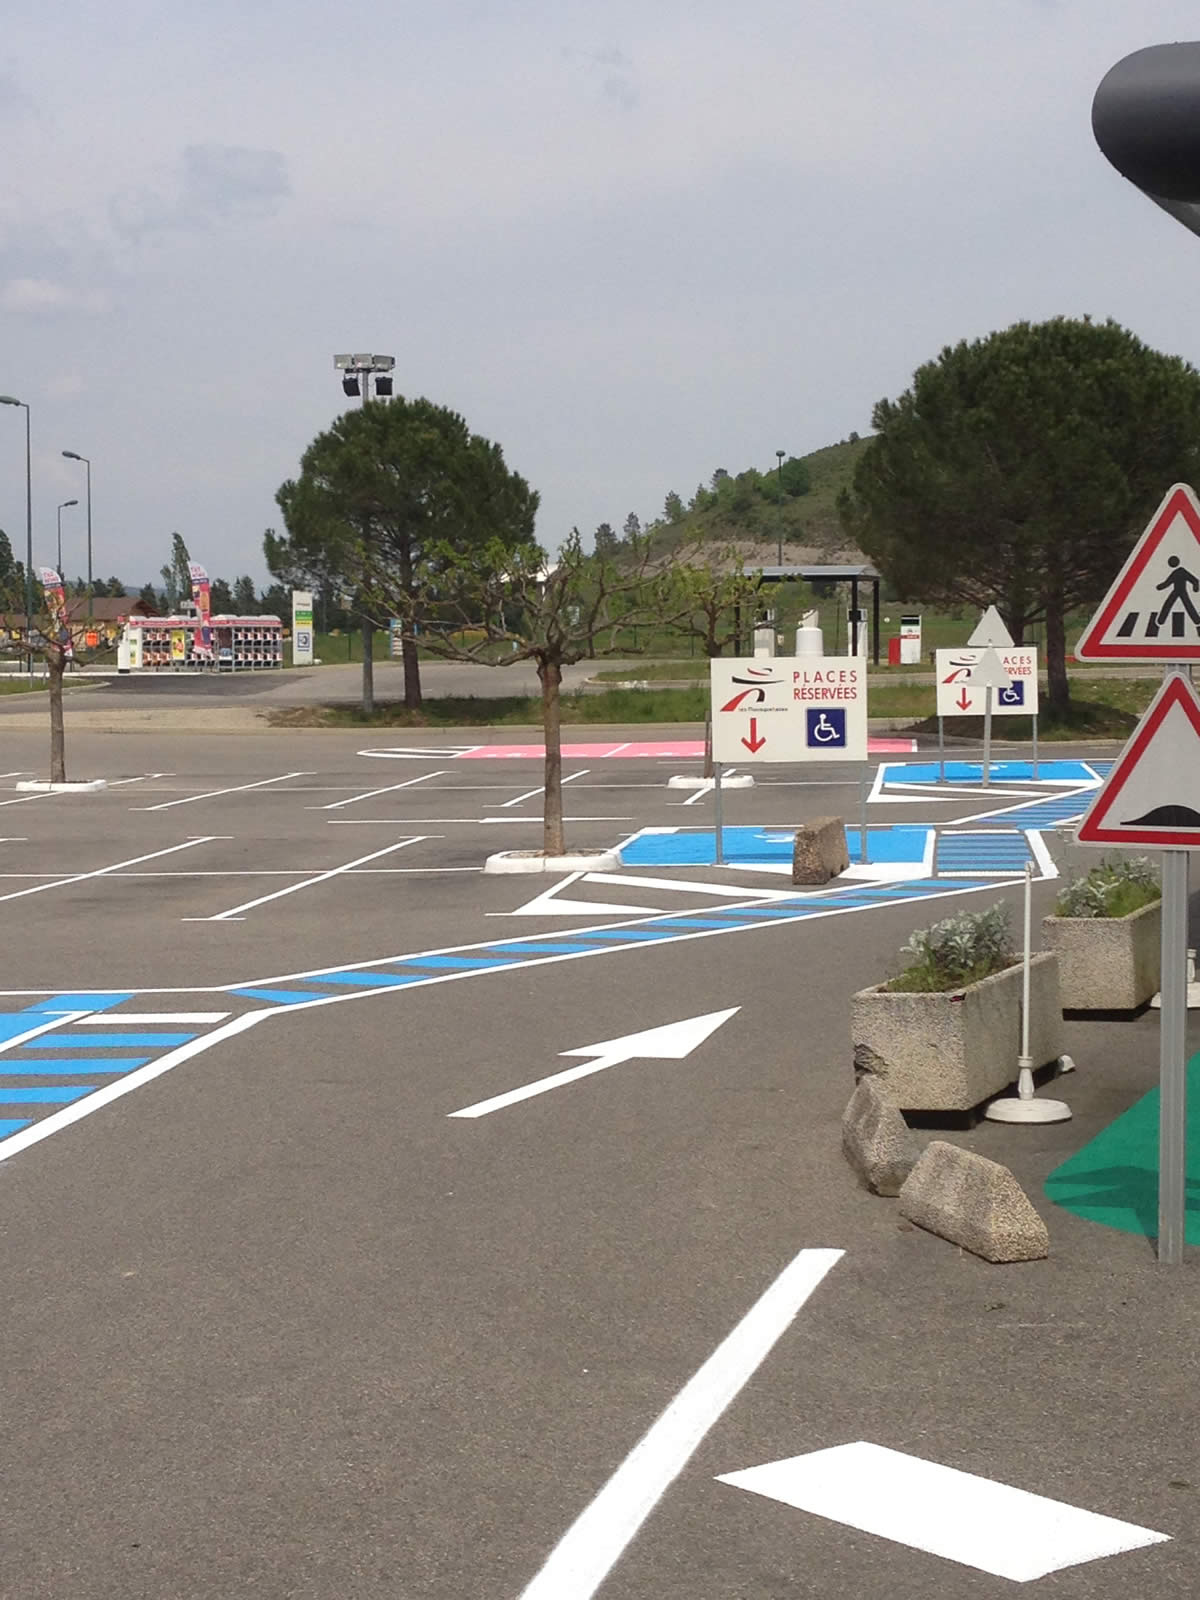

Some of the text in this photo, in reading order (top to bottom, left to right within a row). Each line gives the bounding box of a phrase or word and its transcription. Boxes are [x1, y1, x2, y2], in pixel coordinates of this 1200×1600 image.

[1003, 656, 1032, 665] ACES
[1003, 664, 1032, 675] RVÉES
[792, 670, 858, 683] PLACES
[793, 683, 858, 700] RÉSERVÉES
